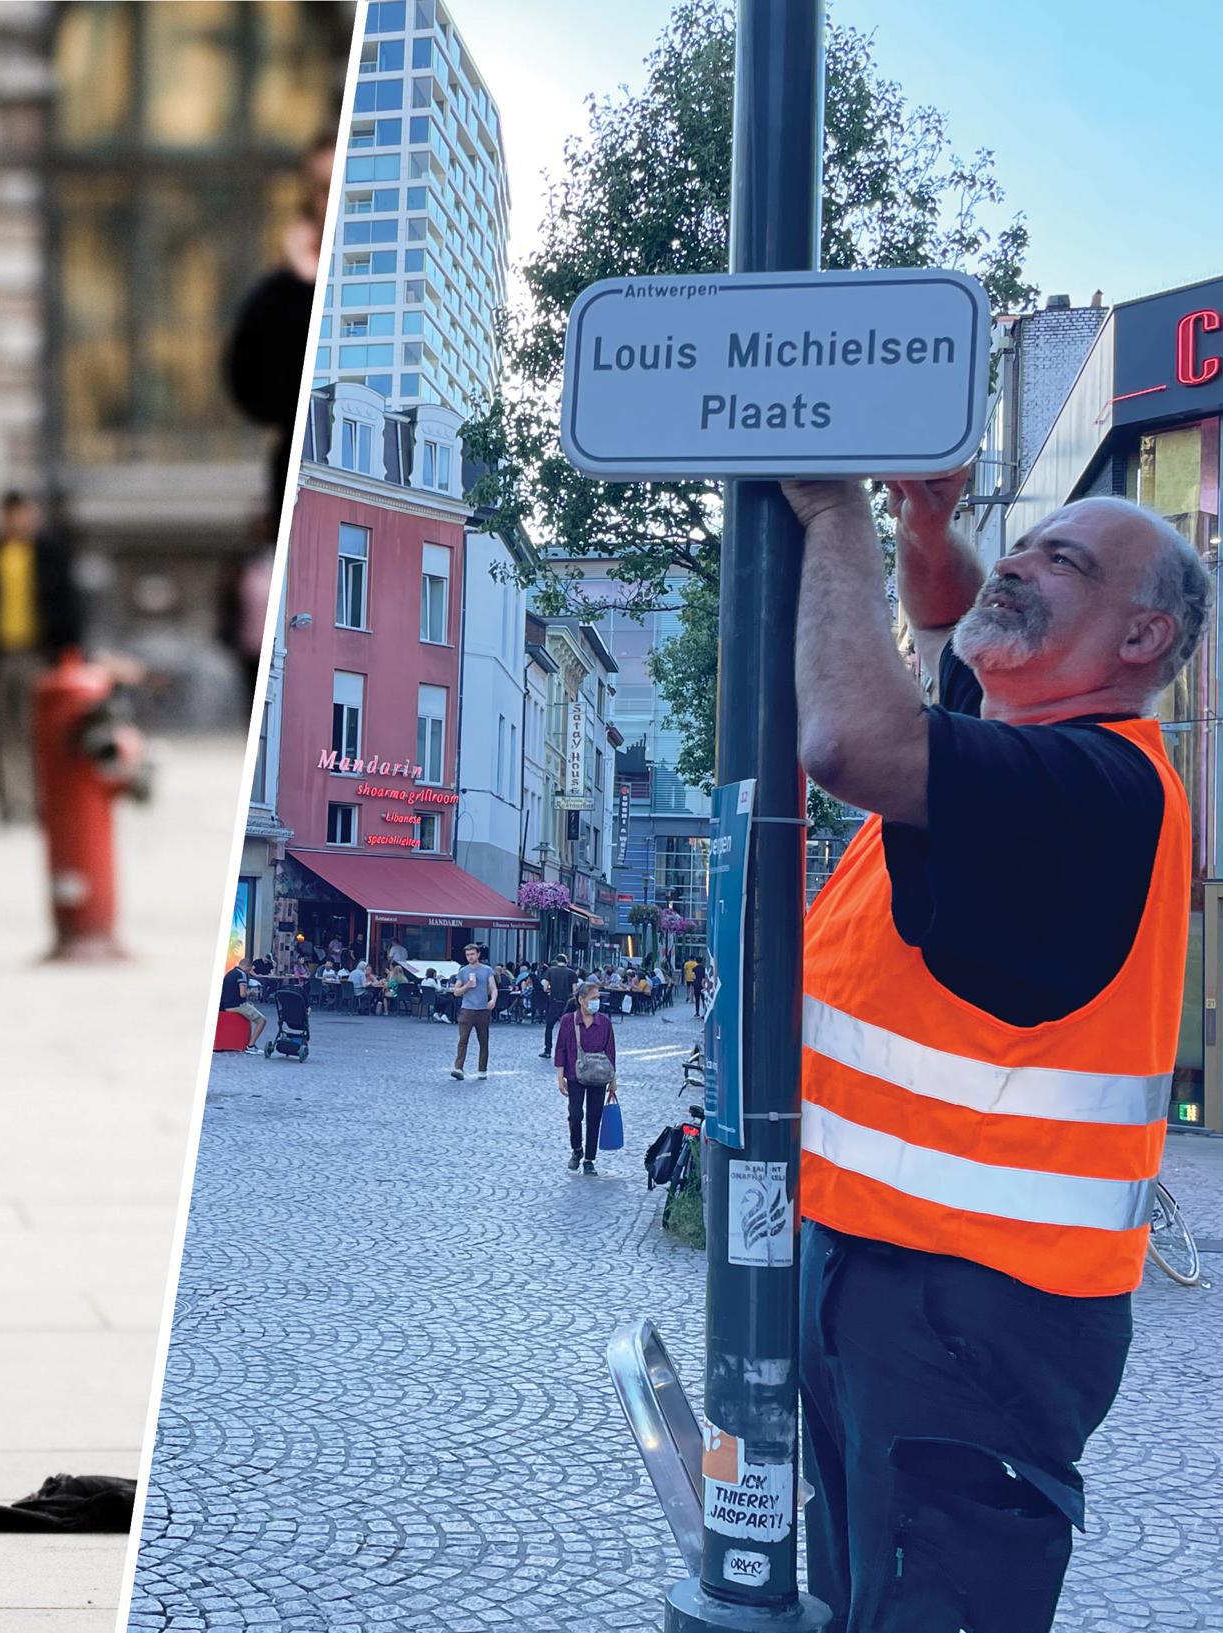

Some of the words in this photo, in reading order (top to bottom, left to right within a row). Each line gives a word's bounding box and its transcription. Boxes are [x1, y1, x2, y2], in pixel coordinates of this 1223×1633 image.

[624, 283, 718, 300] Antwerpen
[593, 335, 697, 371] Louis
[727, 329, 956, 369] Michielsen
[1177, 308, 1220, 386] C
[700, 394, 832, 430] Plaats
[317, 749, 423, 778] Mandarin
[428, 918, 463, 927] MANDARIN
[715, 1486, 780, 1509] THIERRY
[710, 1505, 784, 1529] JASPART!
